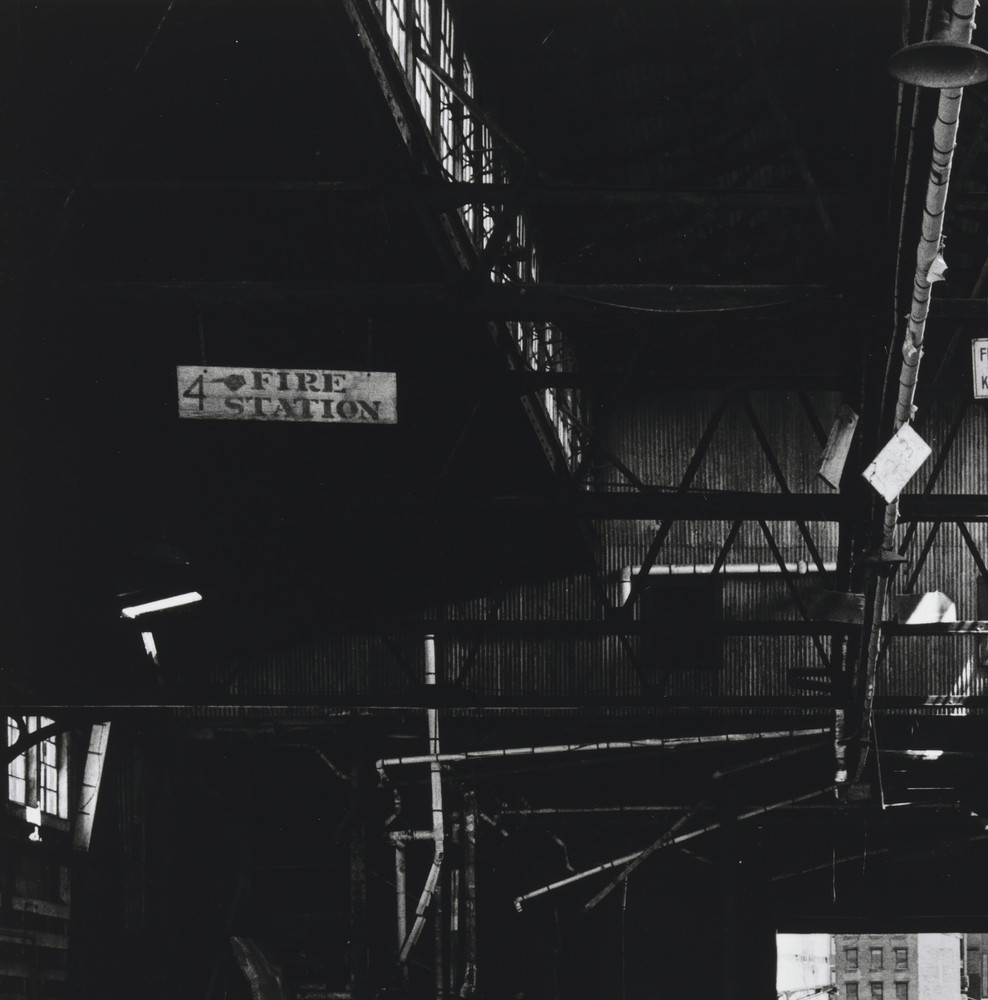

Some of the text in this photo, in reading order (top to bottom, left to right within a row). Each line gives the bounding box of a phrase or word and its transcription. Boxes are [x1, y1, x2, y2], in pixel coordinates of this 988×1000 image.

[182, 371, 346, 411] 4 FIRE
[224, 396, 381, 421] STATION
